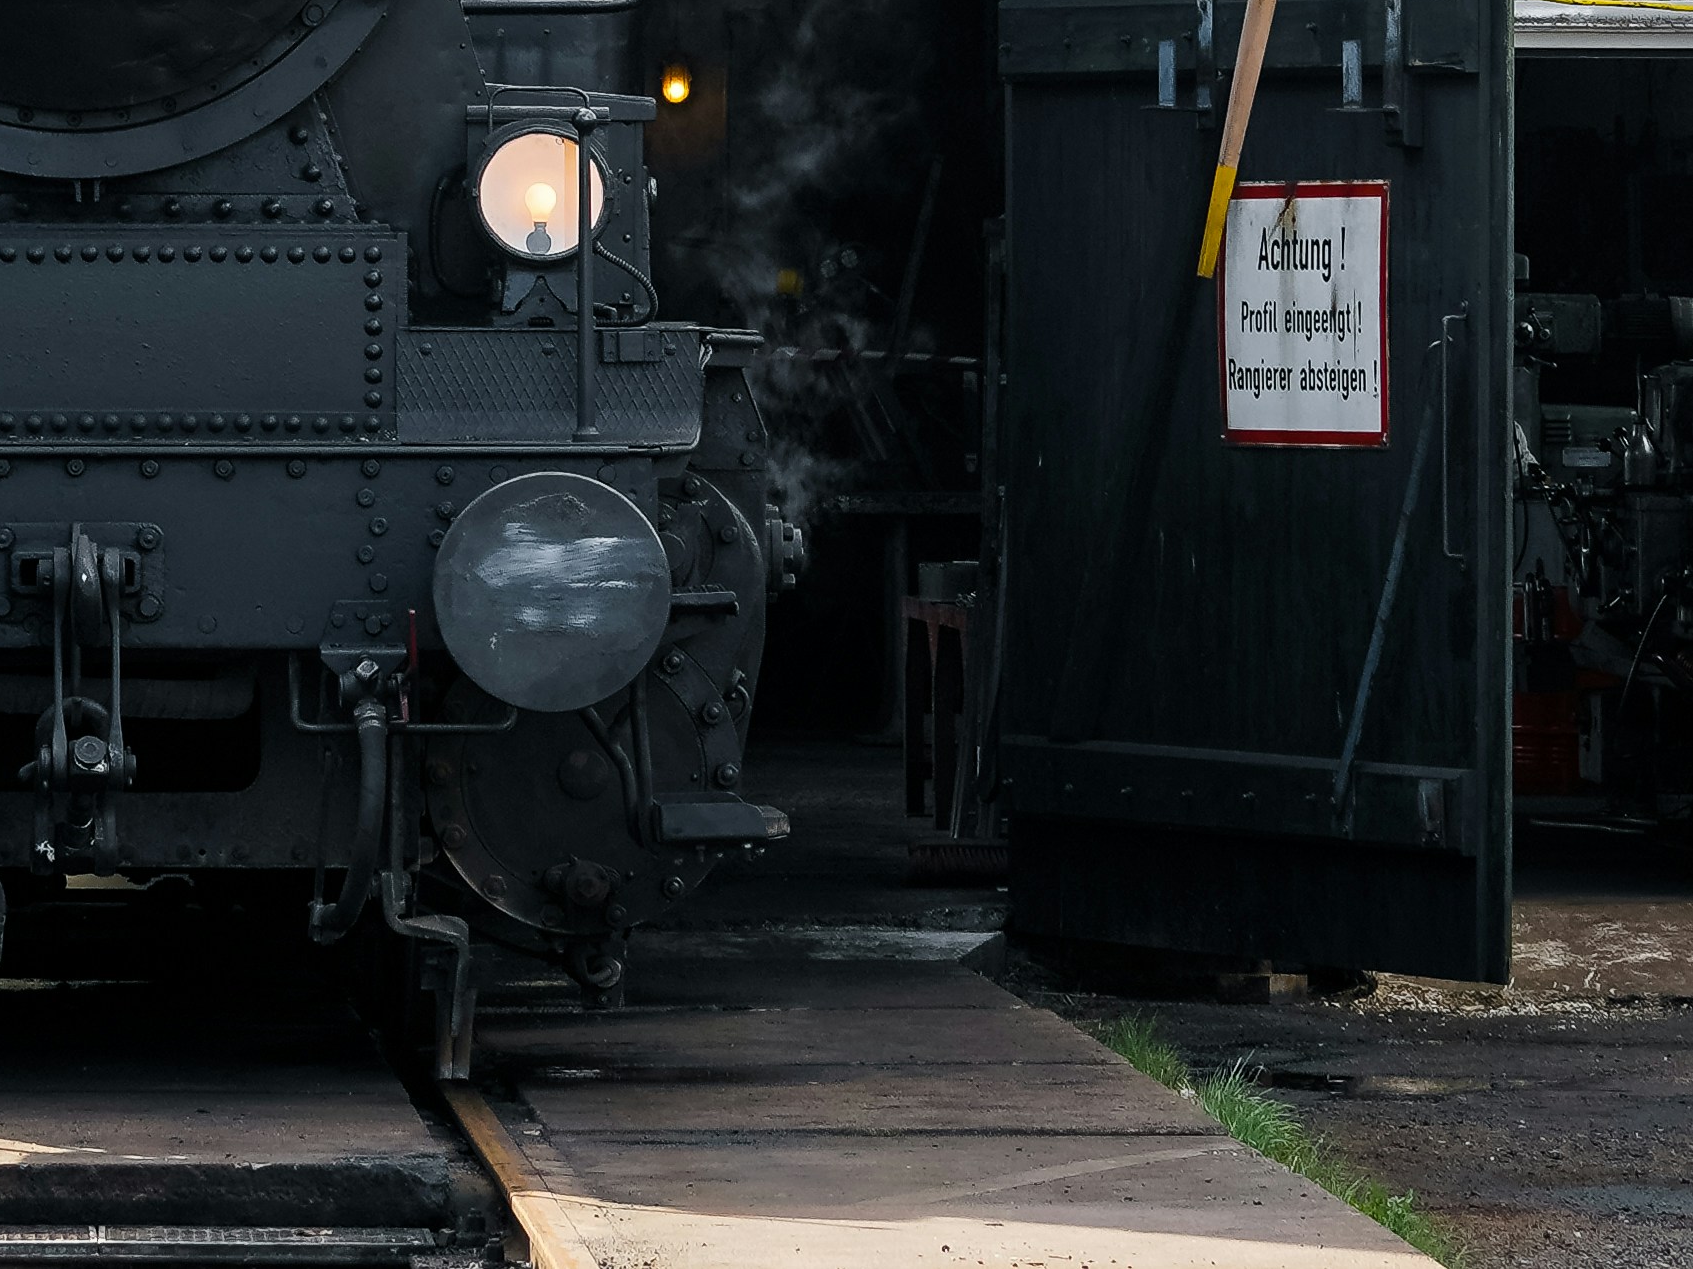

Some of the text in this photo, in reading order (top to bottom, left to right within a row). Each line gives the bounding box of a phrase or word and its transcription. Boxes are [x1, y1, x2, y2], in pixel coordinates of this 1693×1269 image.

[1258, 227, 1332, 282] Achtung
[1241, 300, 1278, 333] Profil
[1284, 301, 1352, 342] eingeengt
[1228, 359, 1293, 399] Rangierer
[1299, 360, 1367, 400] absteigen
